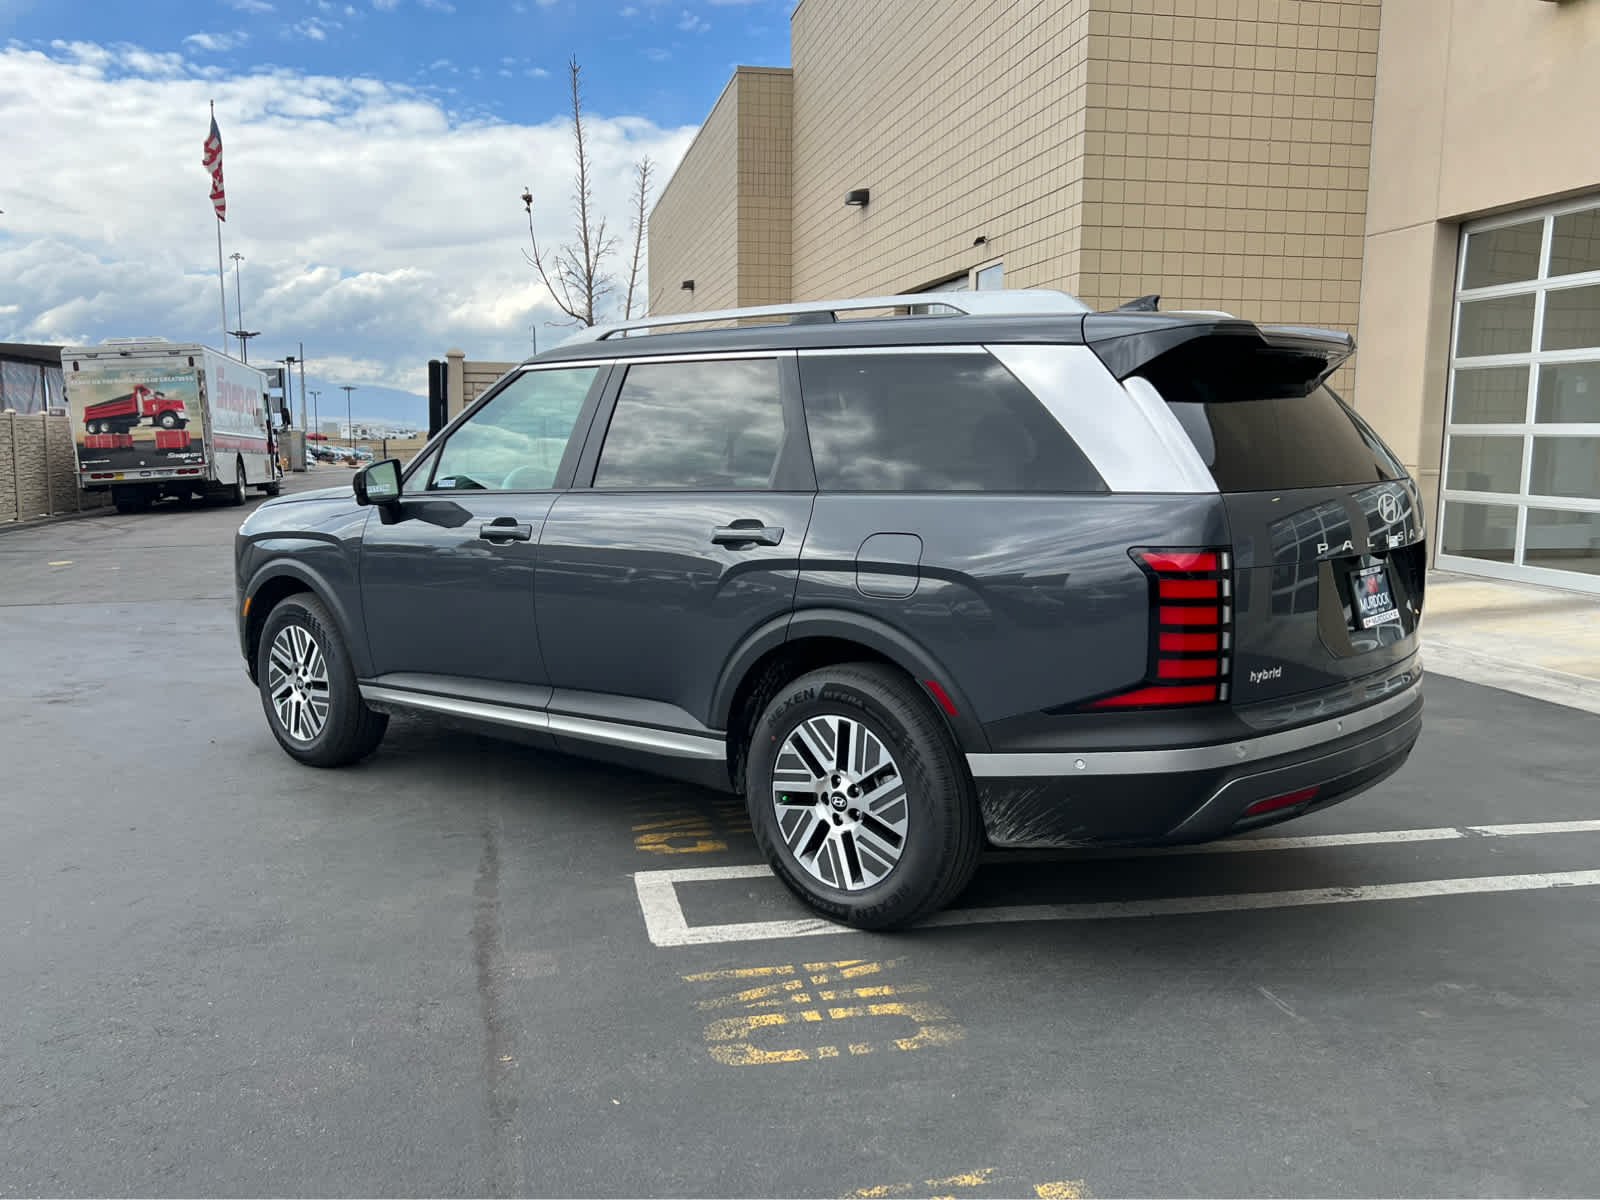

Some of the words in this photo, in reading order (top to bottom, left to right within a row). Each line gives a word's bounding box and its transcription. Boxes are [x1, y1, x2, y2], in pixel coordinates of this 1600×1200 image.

[1360, 592, 1389, 609] MURDOCK
[1249, 666, 1282, 683] hybrid
[767, 687, 815, 725] NEXEN
